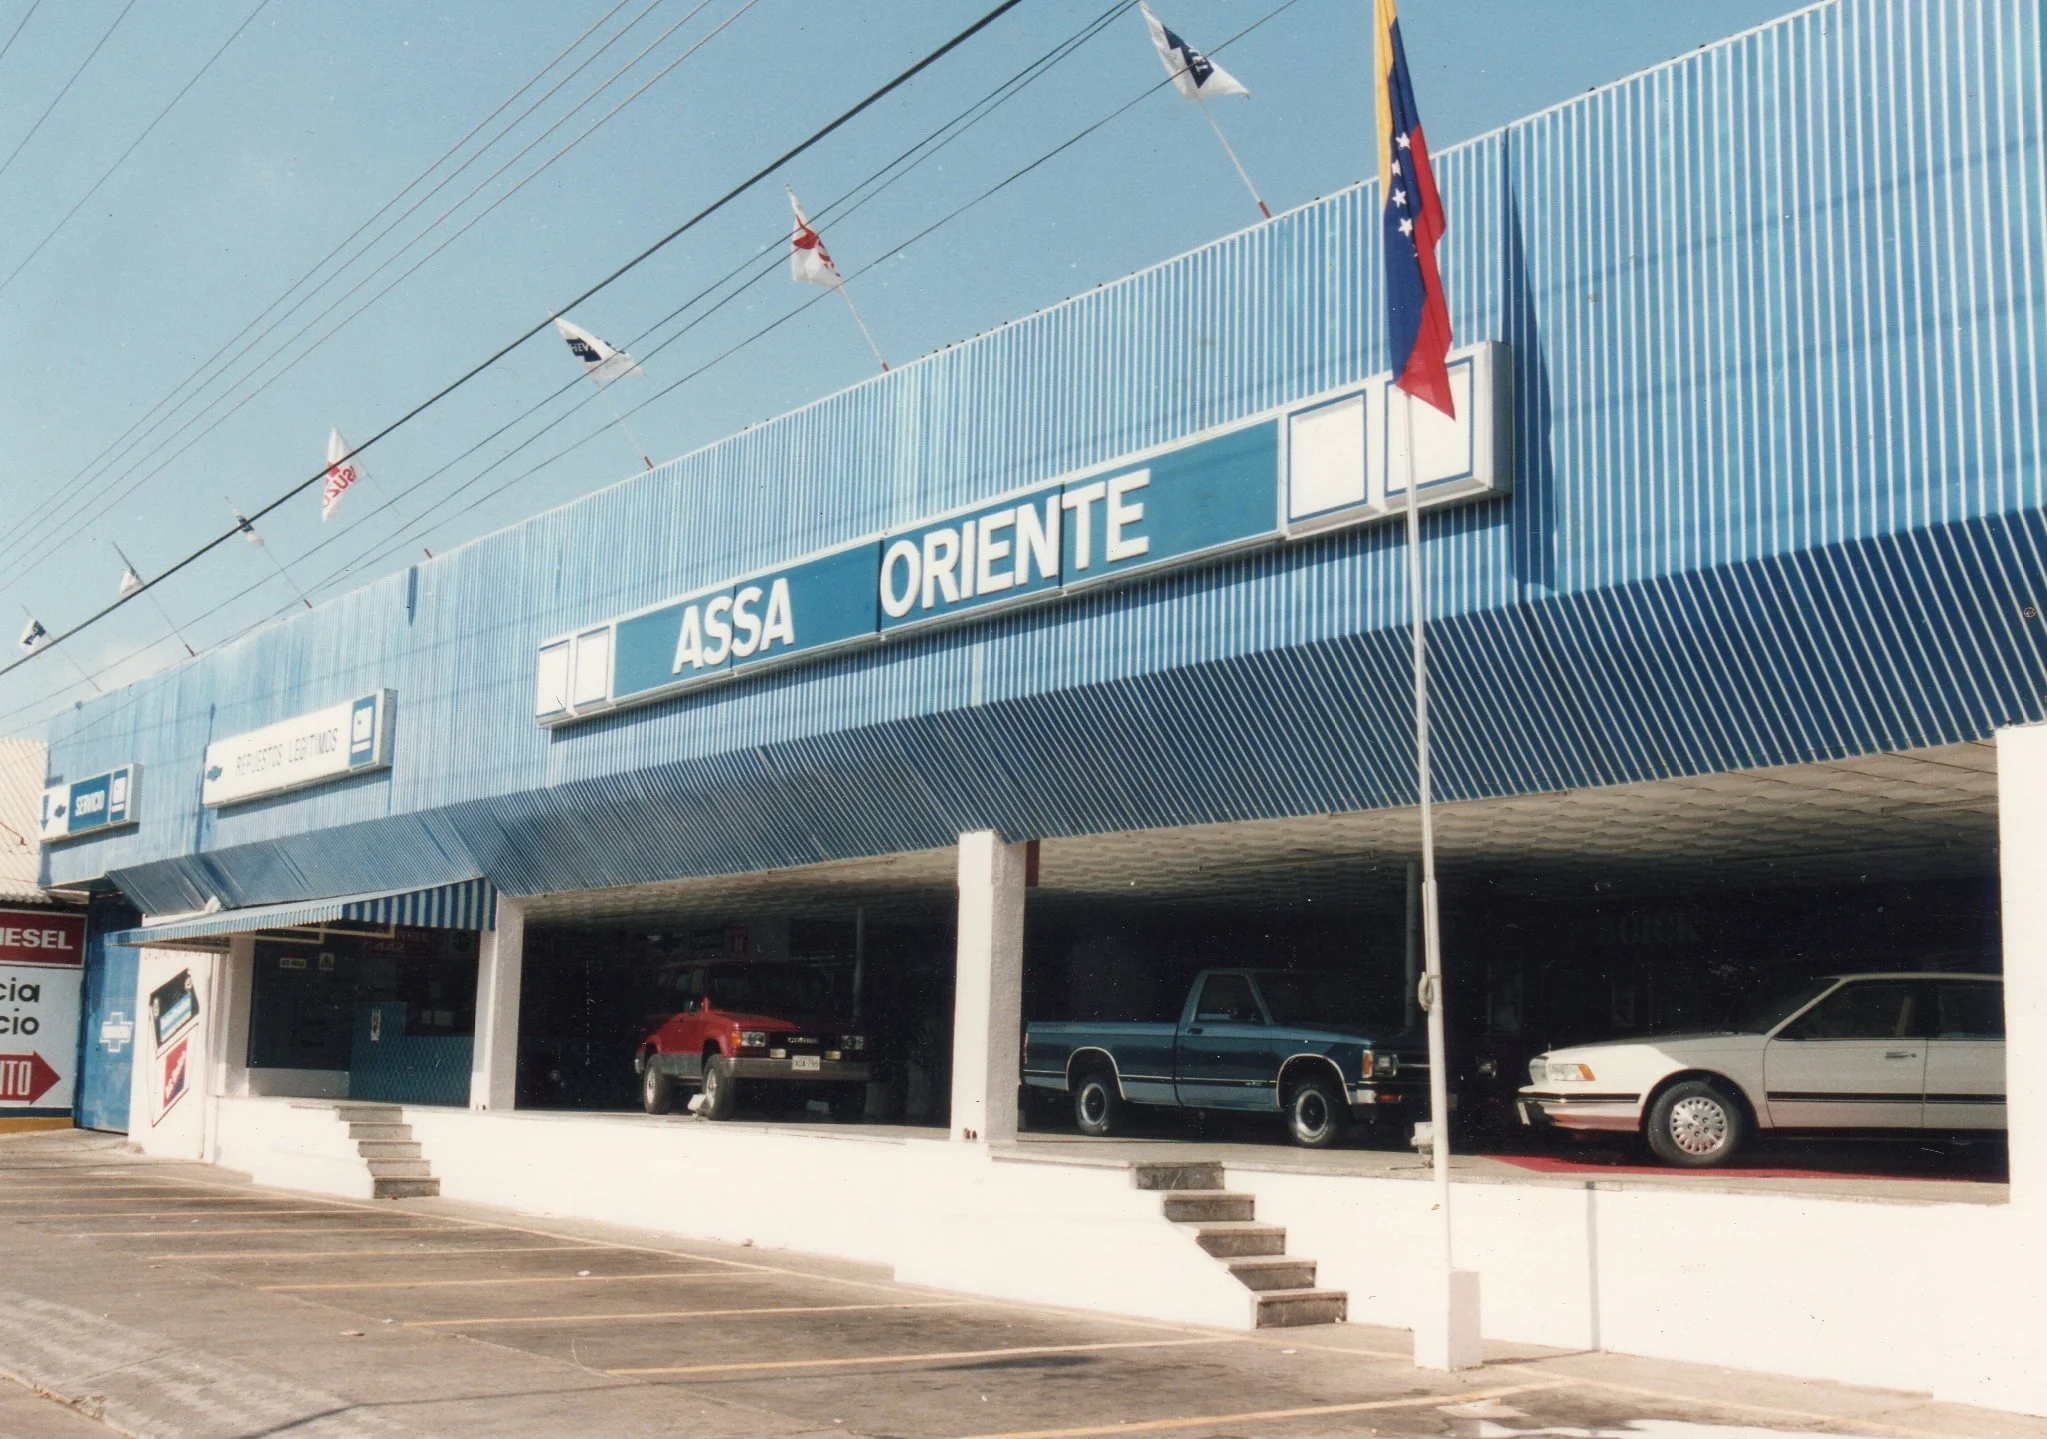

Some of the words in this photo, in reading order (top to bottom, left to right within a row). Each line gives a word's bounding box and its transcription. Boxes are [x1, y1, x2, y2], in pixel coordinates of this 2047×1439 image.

[672, 577, 795, 674] ASSA
[880, 468, 1152, 619] ORIENTE
[235, 742, 283, 776] REPUESTOS
[287, 726, 339, 763] LEGITIMOS
[75, 789, 105, 816] SERVICIO
